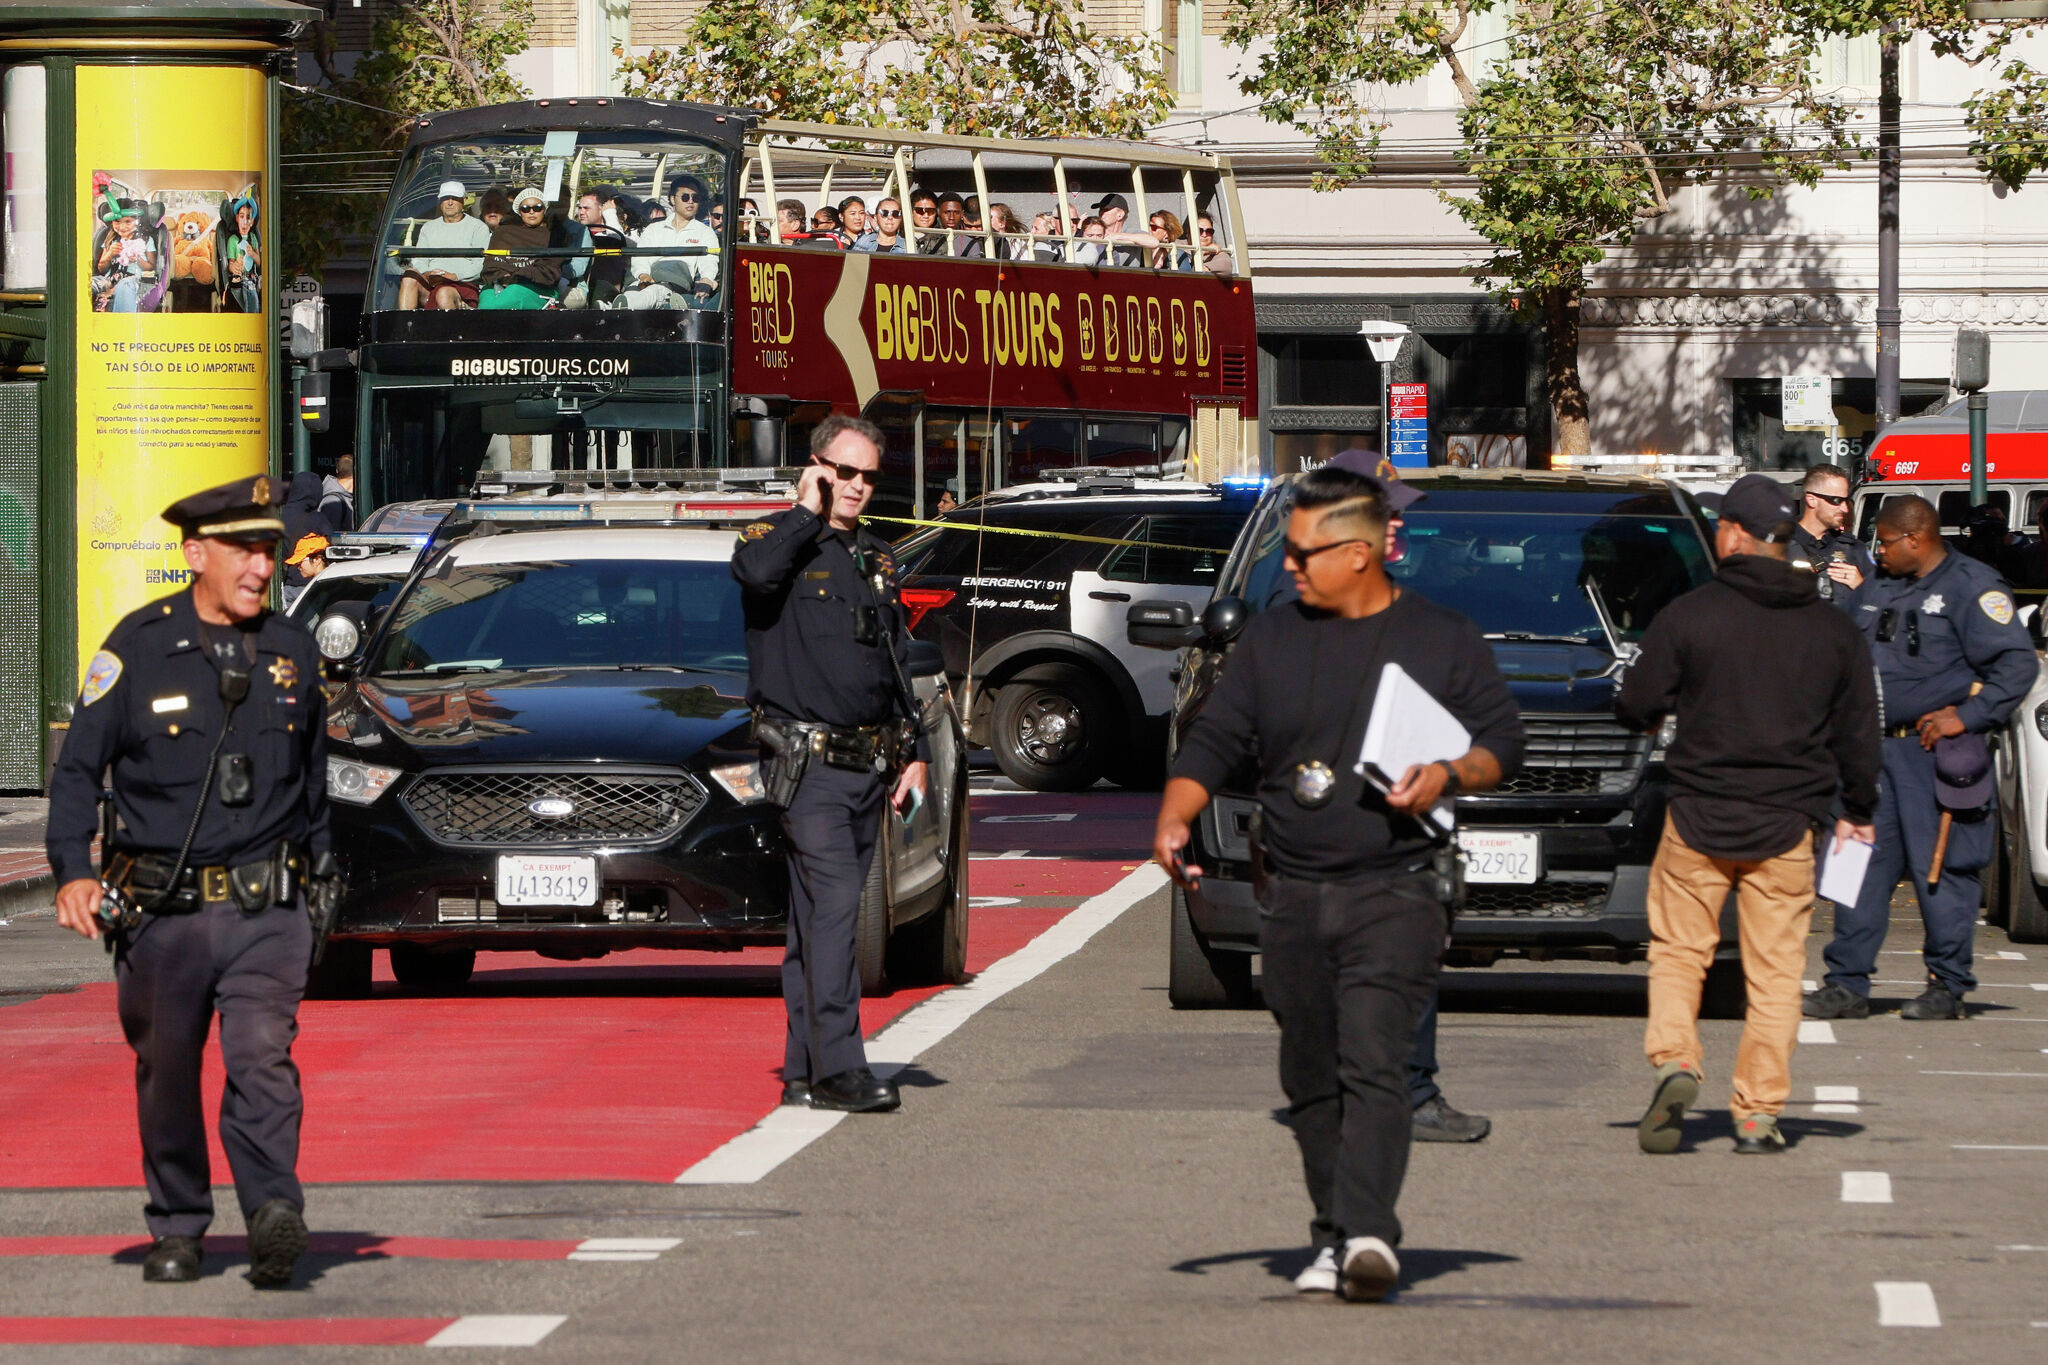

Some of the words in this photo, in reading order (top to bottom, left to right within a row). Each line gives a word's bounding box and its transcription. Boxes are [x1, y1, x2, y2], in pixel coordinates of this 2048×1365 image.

[281, 281, 317, 293] PEED
[749, 262, 774, 303] BIG
[751, 306, 776, 344] BUS
[975, 289, 1064, 368] TOURS
[91, 342, 109, 352] NO
[113, 342, 126, 352] TE
[129, 342, 195, 353] PREOCUPES
[199, 343, 211, 352] DE
[214, 343, 231, 353] LOS
[234, 343, 262, 354] DETALLES,
[761, 350, 788, 369] TOURS
[105, 362, 129, 372] TAN
[133, 360, 163, 373] SÓLO
[168, 362, 182, 372] DE
[186, 362, 200, 372] LO
[203, 363, 257, 373] IMPORTANTE.
[451, 358, 630, 376] BIGBUSTOURS.COM
[1406, 386, 1425, 394] RAPID
[1784, 390, 1799, 400] 800
[1395, 420, 1400, 429] 5
[1395, 431, 1400, 440] 7
[1394, 443, 1403, 453] 38
[1822, 438, 1863, 457] 665
[1895, 461, 1919, 475] 6697
[164, 542, 177, 551] en
[961, 577, 1040, 590] EMERGENCY
[1046, 580, 1067, 591] 911
[967, 597, 998, 609] Safety
[1000, 599, 1020, 609] with
[1022, 599, 1059, 612] Respect
[1463, 839, 1475, 847] CA
[1479, 839, 1512, 847] EXEMPT
[539, 864, 572, 872] EXEMPT
[1470, 852, 1529, 875] 52902
[506, 875, 588, 898] 1413619
